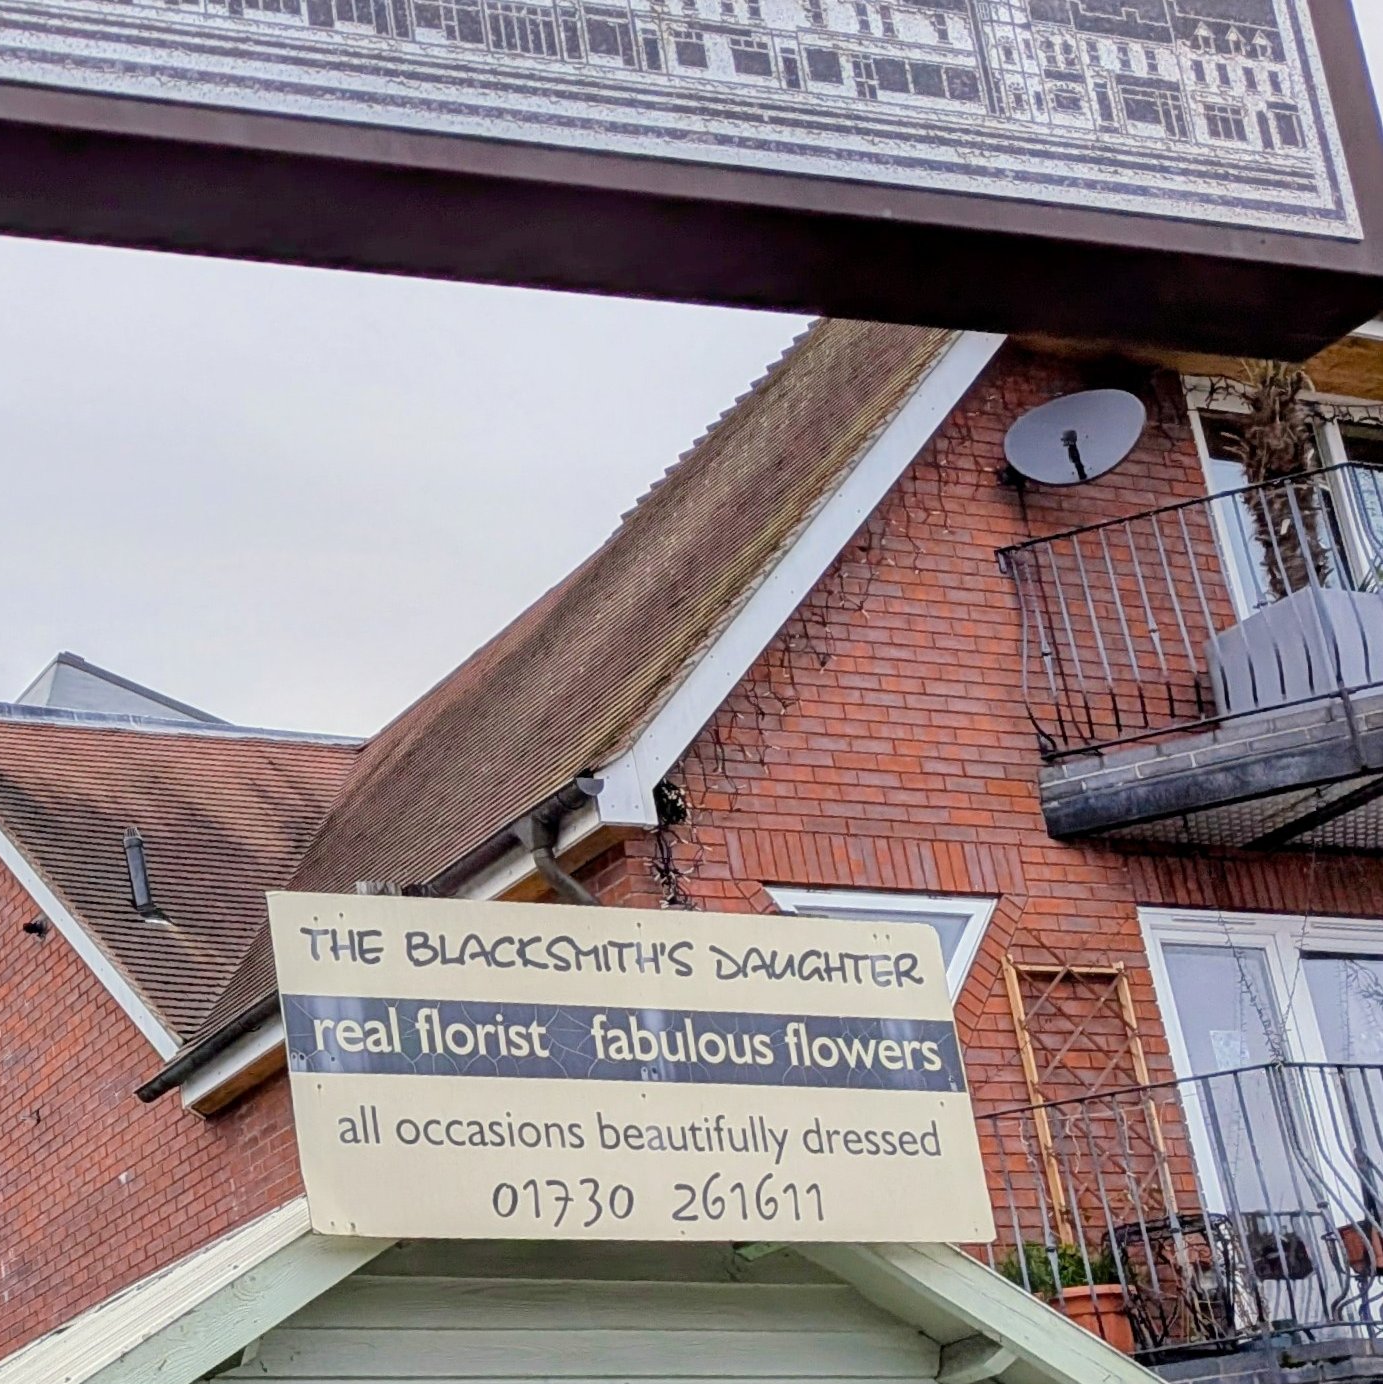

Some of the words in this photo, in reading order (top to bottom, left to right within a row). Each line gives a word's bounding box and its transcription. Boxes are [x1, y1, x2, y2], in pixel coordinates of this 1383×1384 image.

[300, 926, 384, 965] THE
[405, 930, 694, 977] BLACKSMITH'S
[709, 944, 924, 987] DAUGHTER
[313, 1006, 401, 1054] real
[415, 1007, 550, 1057] florist
[590, 1014, 773, 1065] fabulous
[784, 1022, 942, 1071] flowers
[338, 1104, 381, 1144] all
[396, 1111, 585, 1149] occasions
[596, 1111, 788, 1165] beautifully
[802, 1117, 942, 1157] dressed
[492, 1177, 634, 1227] 01730
[672, 1172, 824, 1222] 261611
